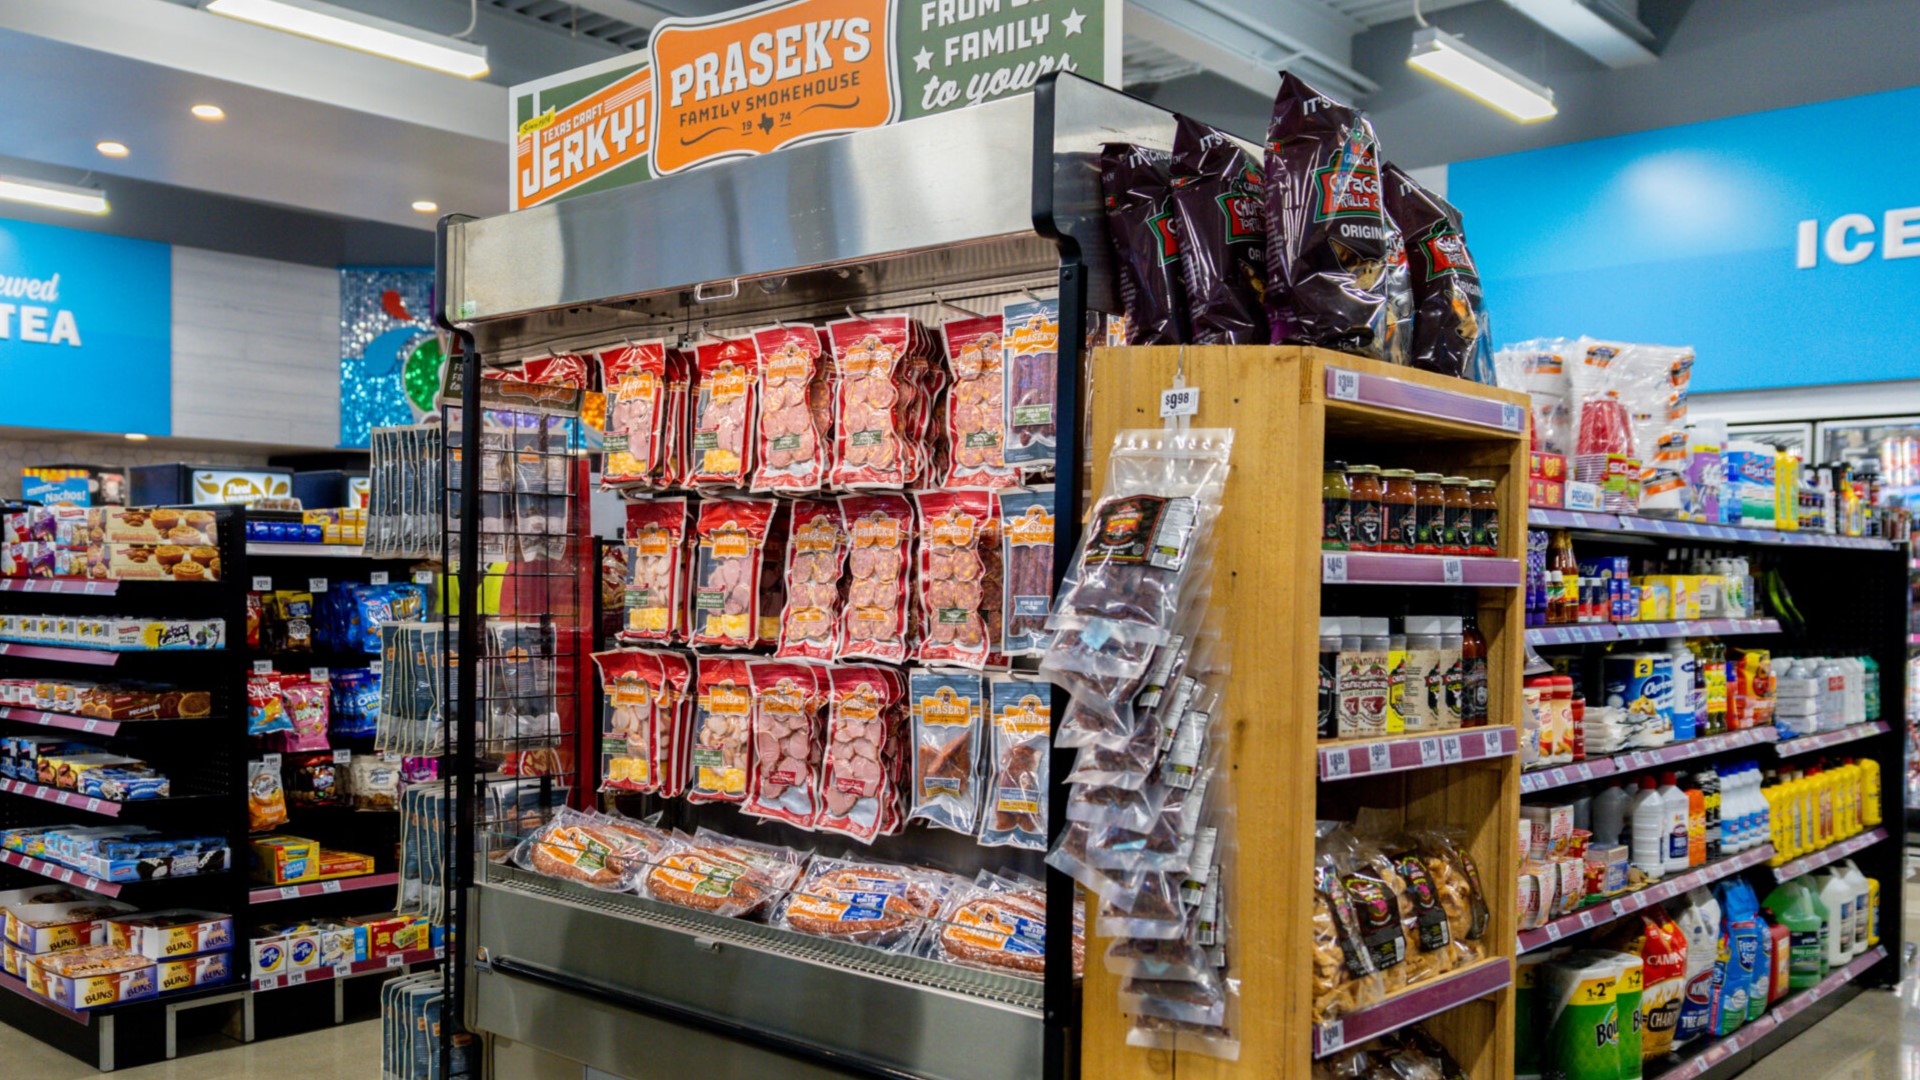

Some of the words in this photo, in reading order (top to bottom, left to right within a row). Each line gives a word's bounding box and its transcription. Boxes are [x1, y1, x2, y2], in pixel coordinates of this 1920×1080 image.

[945, 13, 1050, 66] FAMILY
[671, 17, 870, 108] PRASEK'S
[680, 99, 741, 128] FAMILY
[746, 70, 861, 112] SMOKEHOUSE
[921, 75, 961, 110] to
[1302, 95, 1332, 116] IT'S
[543, 119, 572, 144] TEXAS
[573, 102, 604, 129] CRAFT
[742, 120, 753, 131] 19
[779, 112, 791, 123] 74
[521, 92, 647, 199] JERKY!
[1200, 132, 1223, 152] IT'S
[1796, 206, 1920, 269] ICE
[0, 303, 82, 346] TEA
[1015, 331, 1057, 344] PRASEK'S
[45, 490, 86, 503] Nachos!
[858, 527, 895, 538] PRASEK'S
[715, 535, 745, 546] PRASEK'S
[1640, 663, 1648, 674] 2
[712, 694, 746, 705] PRASEK'S
[925, 704, 966, 715] PRASEK'S
[49, 937, 77, 952] BUNS
[166, 940, 192, 954] BUNS
[205, 935, 229, 948] BUNS
[163, 974, 190, 988] BUNS
[202, 968, 226, 981] BUNS
[84, 989, 113, 1005] BUNS
[127, 983, 152, 998] BUNS
